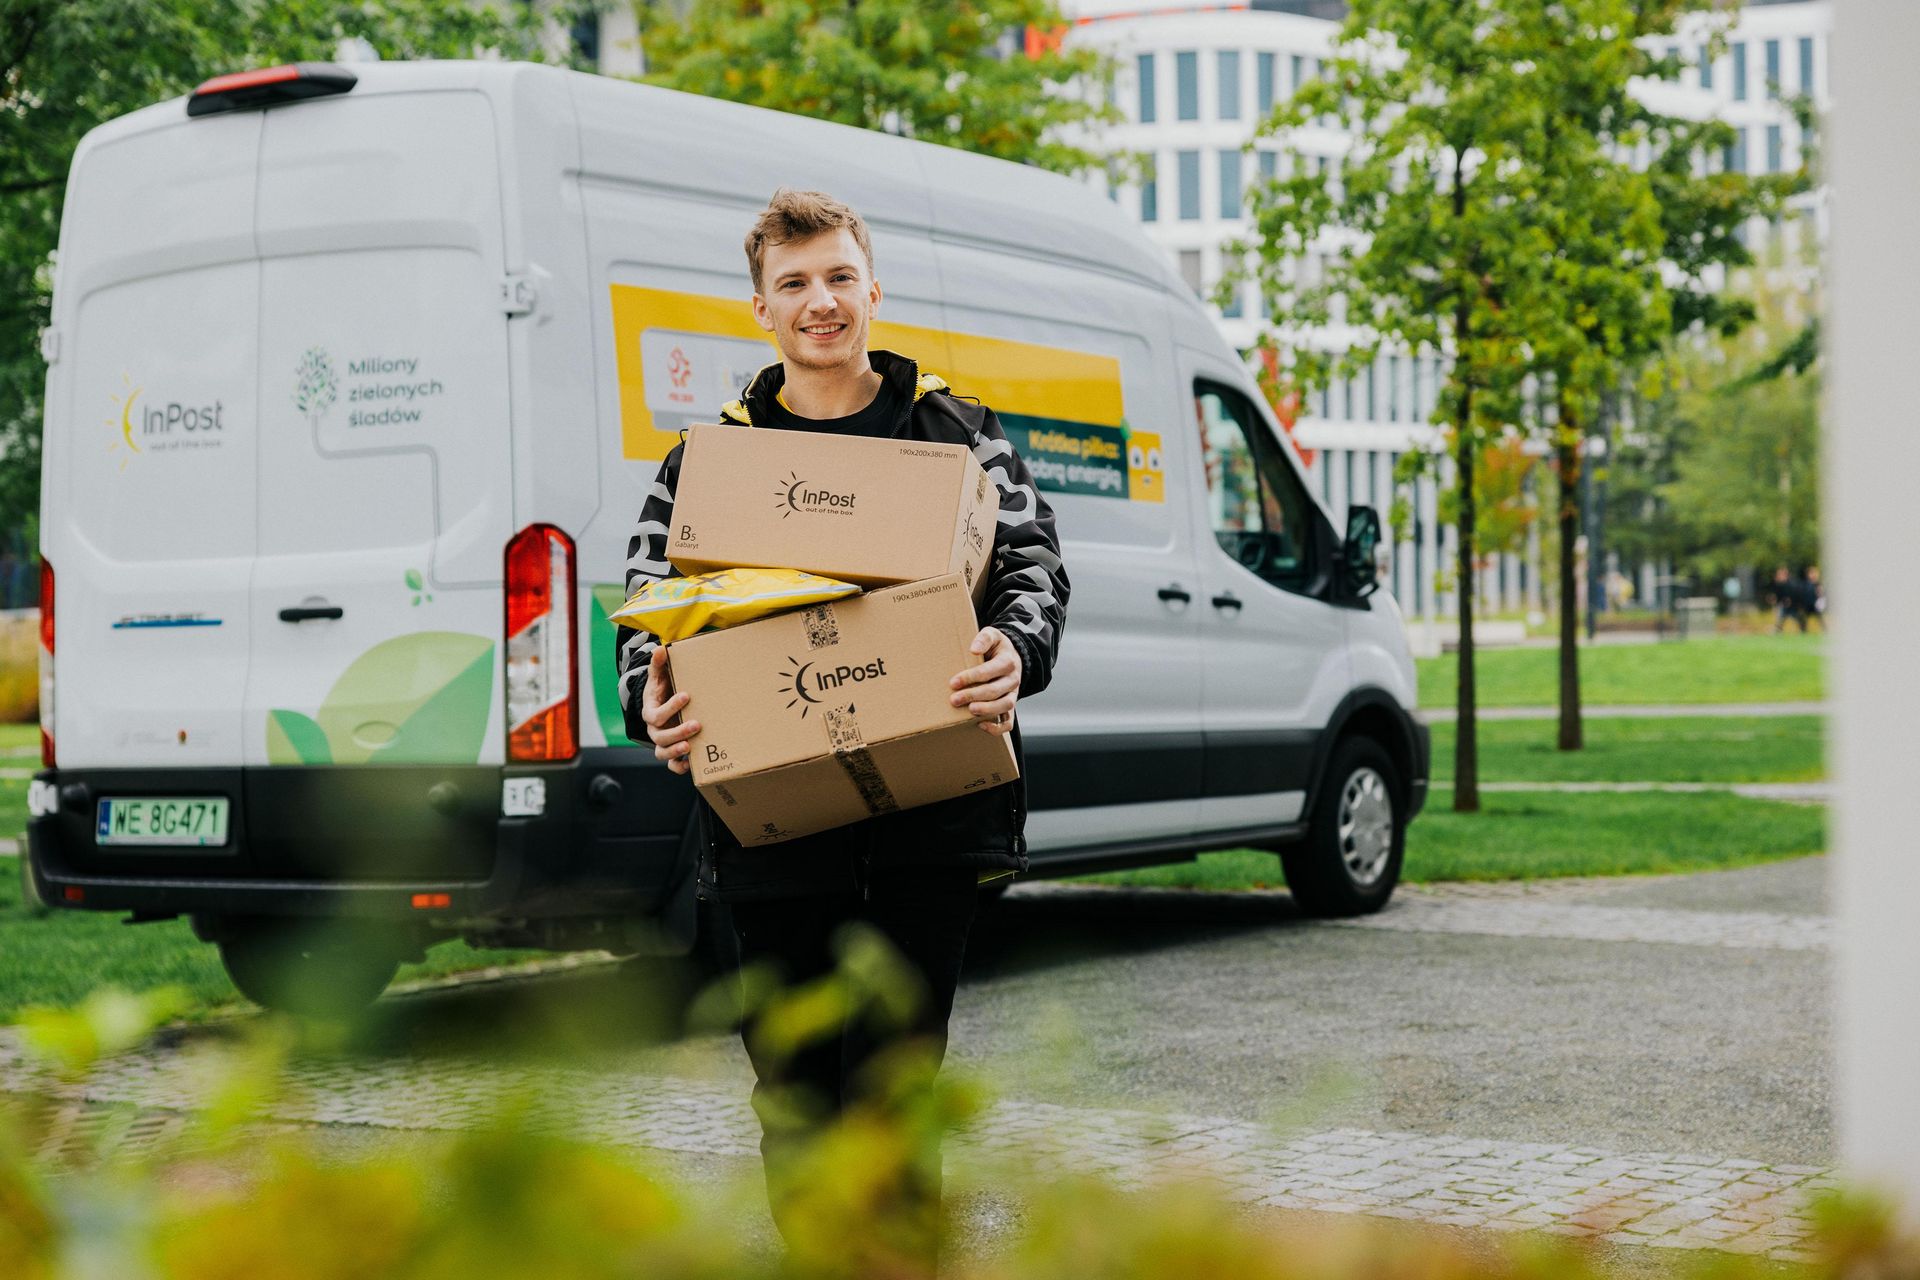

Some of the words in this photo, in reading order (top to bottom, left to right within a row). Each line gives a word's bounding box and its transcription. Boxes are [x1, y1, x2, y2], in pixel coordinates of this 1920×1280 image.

[348, 357, 419, 375] Miliony
[349, 379, 443, 401] zielonych
[143, 400, 223, 434] InPost
[349, 406, 421, 427] śladów
[900, 448, 943, 458] 190x200x380
[802, 489, 856, 508] InPost
[680, 525, 696, 541] B5
[674, 541, 699, 550] Gabaryt
[892, 585, 941, 603] 190x380x400
[942, 582, 958, 591] mm
[816, 658, 887, 691] InPost
[706, 744, 728, 763] B6
[703, 762, 734, 775] Gabaryt
[115, 803, 141, 834] WE
[150, 803, 218, 834] 8G471
